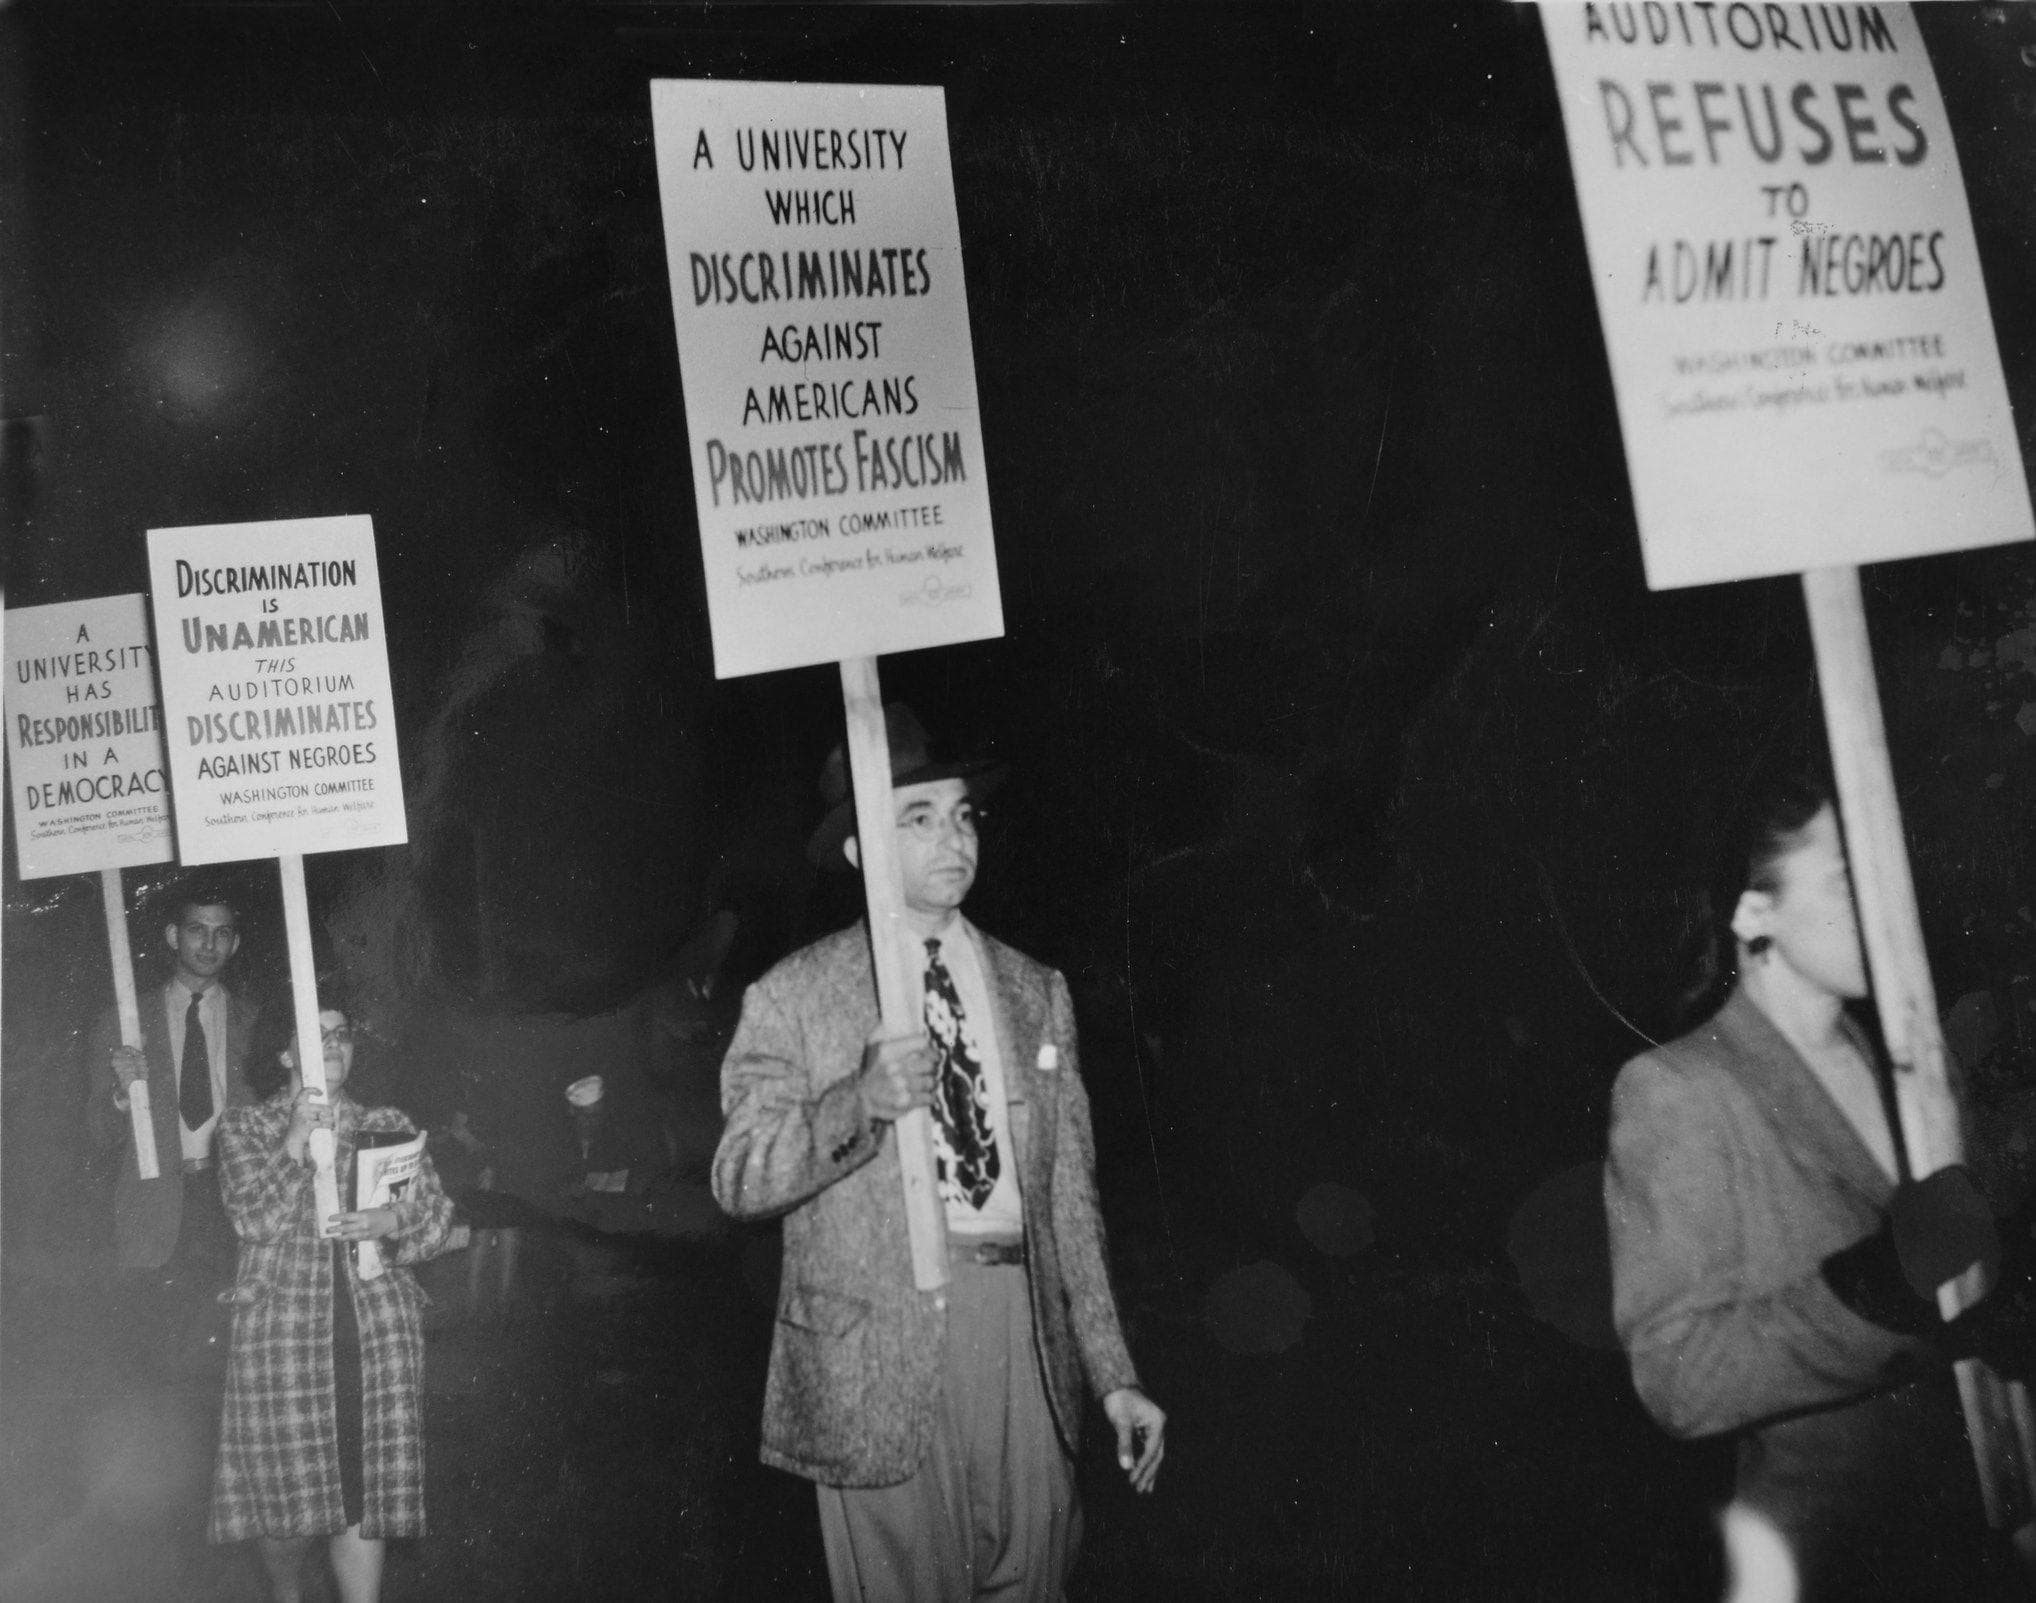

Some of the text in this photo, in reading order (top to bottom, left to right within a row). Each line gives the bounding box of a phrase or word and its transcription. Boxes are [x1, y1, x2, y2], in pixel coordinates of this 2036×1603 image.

[1587, 2, 1898, 52] AUDITORIUM
[1599, 79, 1929, 168] REFUSES
[693, 128, 907, 172] A UNIVERSITY
[765, 189, 856, 225] WHICH
[1762, 182, 1809, 218] TO
[690, 248, 931, 306] DISCRIMINATES
[1642, 230, 1945, 303] ADMIT NEGROES
[760, 321, 882, 363] AGAINST
[743, 375, 919, 426] AMERICANS
[706, 429, 967, 507] PROMOTES FASCISM
[734, 504, 944, 548] WASHINGTON COMMITTEE
[175, 559, 358, 598] DISCRIMINATION
[262, 598, 280, 614] IS
[76, 623, 90, 644] A
[181, 611, 370, 654] UNAMERICAN
[255, 657, 296, 674] THIS
[66, 680, 112, 703] HAS
[208, 674, 355, 702] AUDITORIUM
[17, 704, 161, 748] RESPONSIBILIT
[187, 699, 377, 746] DISCRIMINATES
[64, 746, 119, 769] IN A
[198, 742, 376, 780] AGAINST NEGROES
[219, 778, 375, 805] WASHINGTON COMMITTEE
[38, 805, 159, 828] WASHINGTON COMMITTEE
